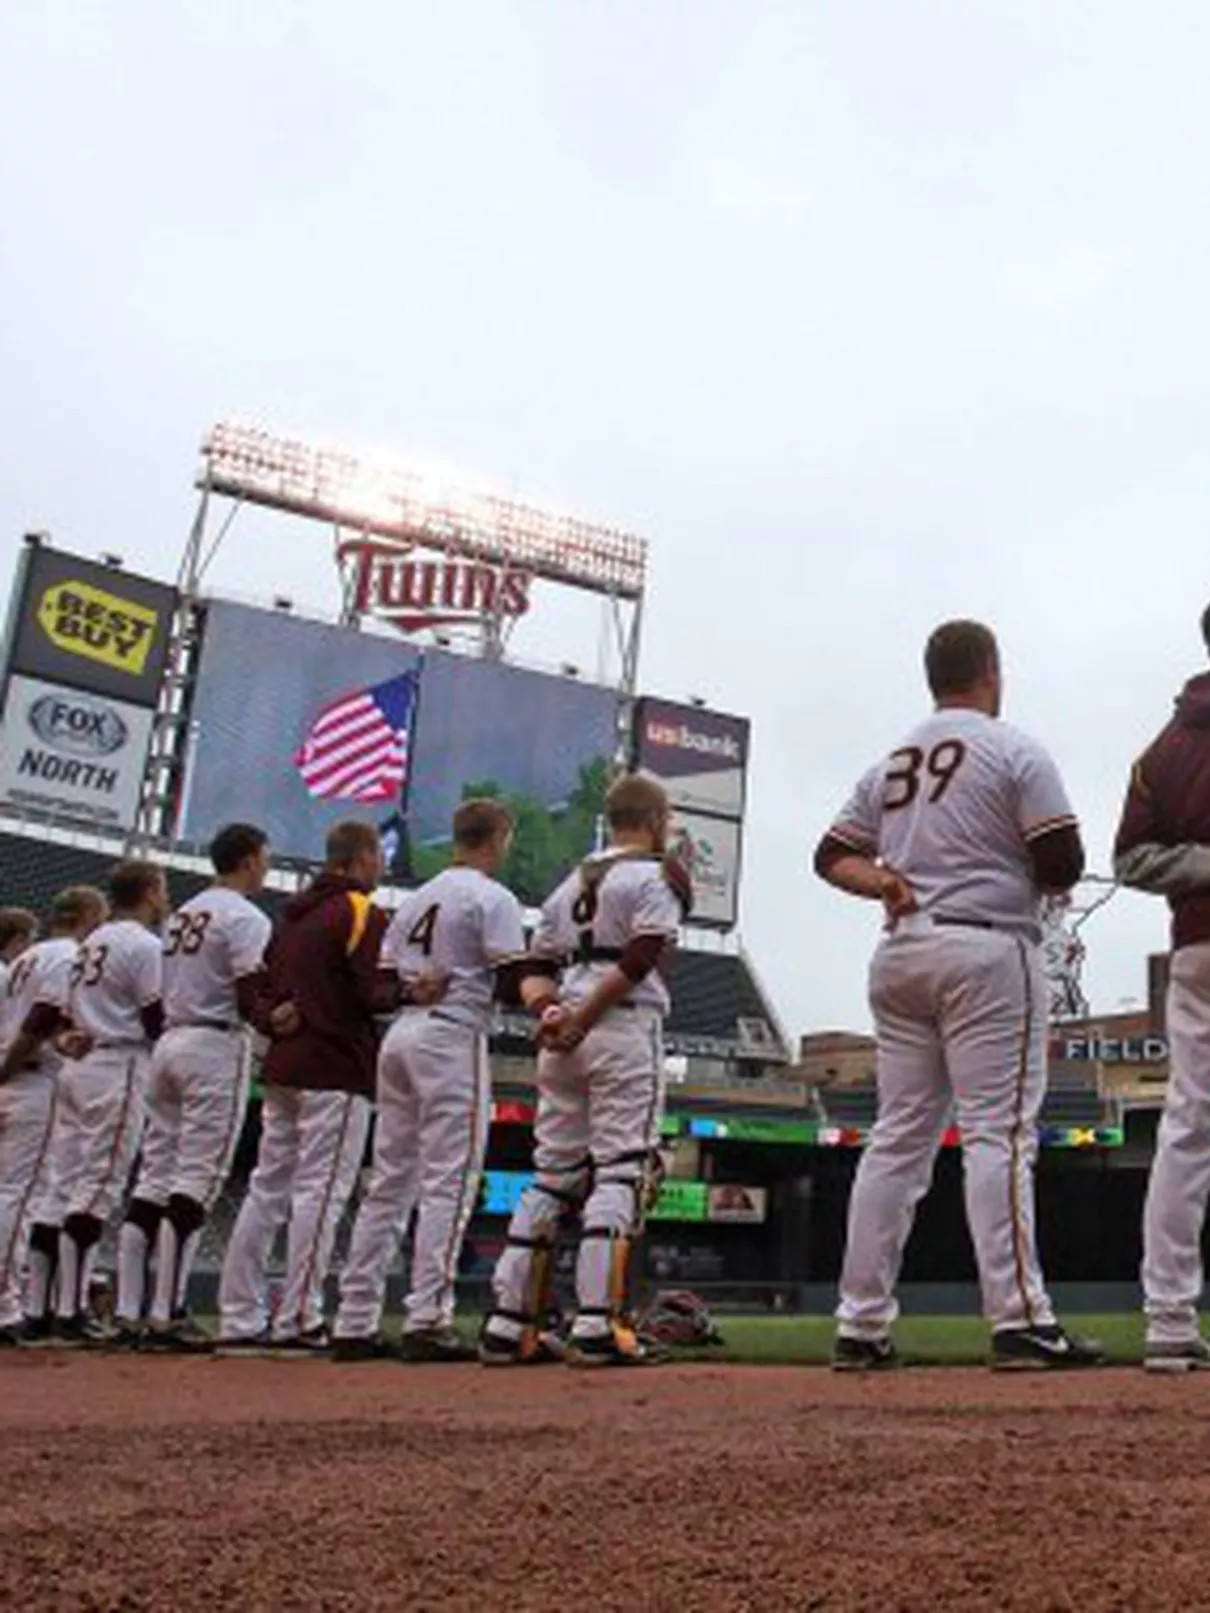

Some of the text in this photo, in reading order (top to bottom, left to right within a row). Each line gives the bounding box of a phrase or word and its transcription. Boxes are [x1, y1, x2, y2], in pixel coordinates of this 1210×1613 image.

[336, 541, 530, 616] Twins
[54, 614, 139, 658] BUY
[57, 590, 153, 637] BEST
[51, 702, 107, 737] FOX
[17, 748, 119, 794] NORTH
[882, 738, 967, 813] 39
[407, 902, 441, 956] 4
[1066, 1038, 1168, 1061] FIELD
